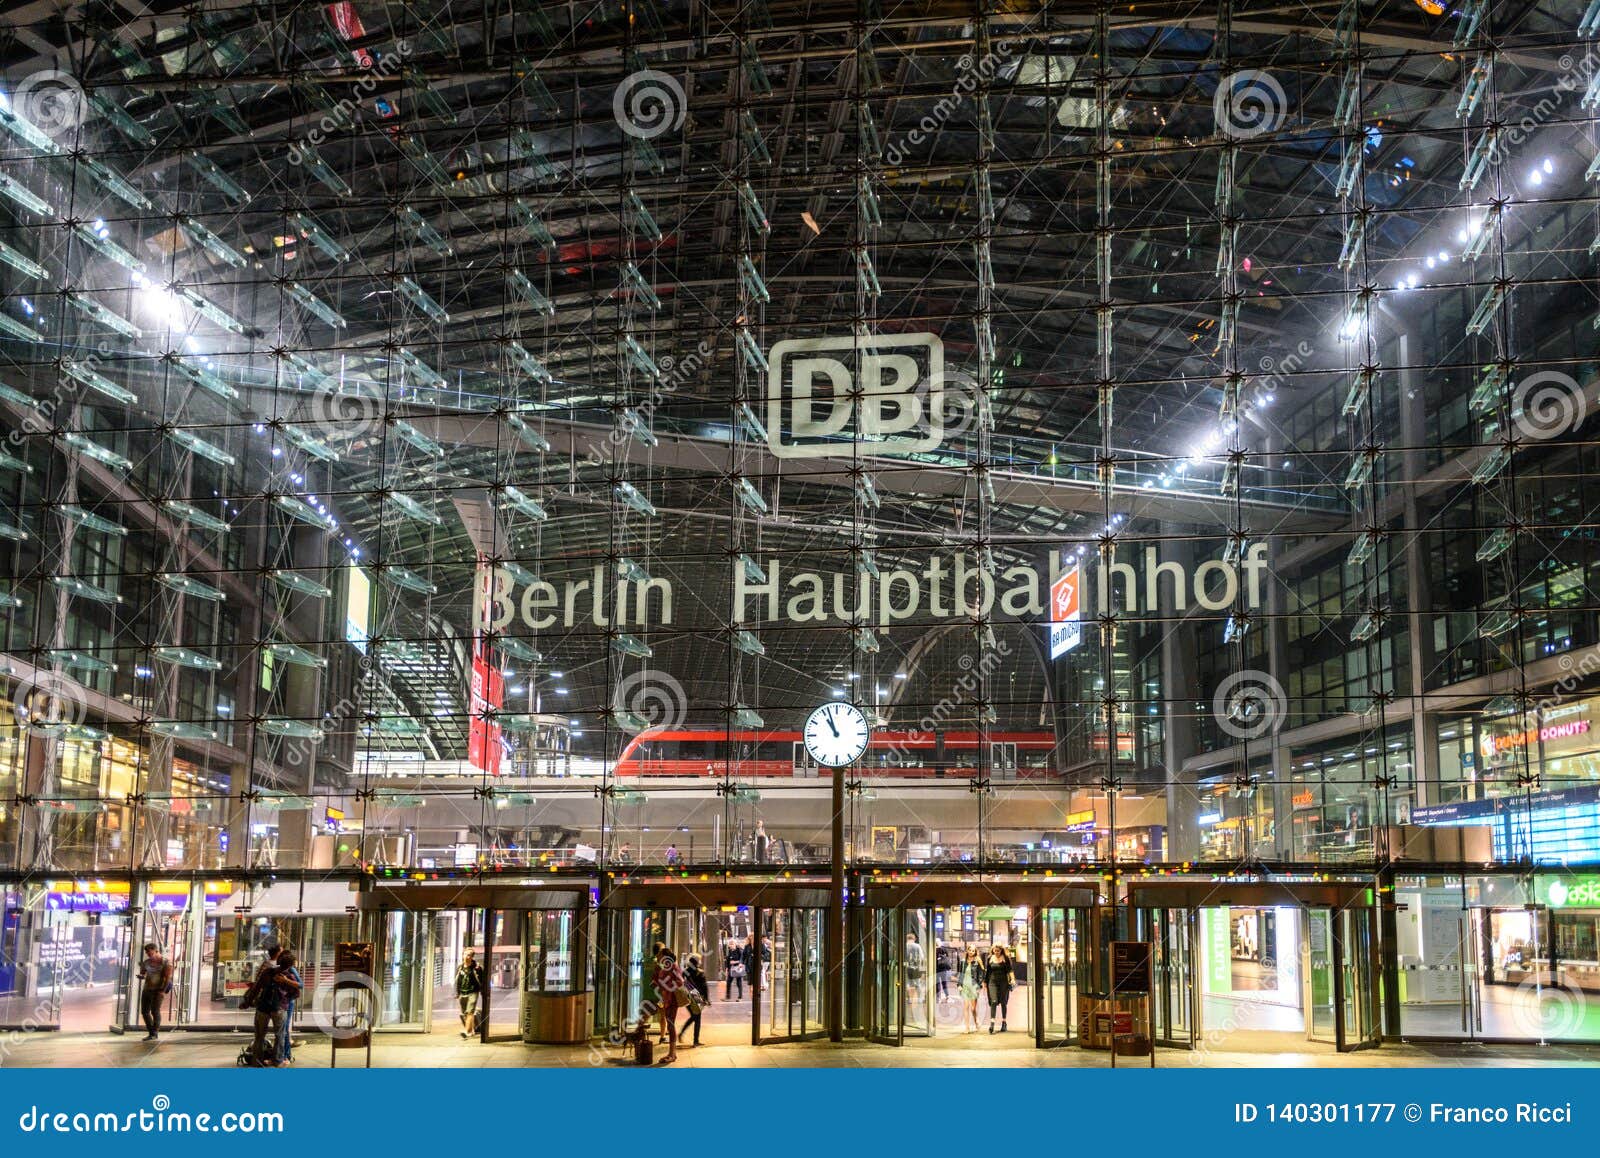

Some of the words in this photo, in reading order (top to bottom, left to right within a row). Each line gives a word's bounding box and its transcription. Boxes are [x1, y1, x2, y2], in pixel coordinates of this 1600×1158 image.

[791, 353, 923, 440] DB
[472, 562, 673, 630] Berlin
[1541, 720, 1589, 741] DONUTS
[1081, 1012, 1089, 1040] Abfall
